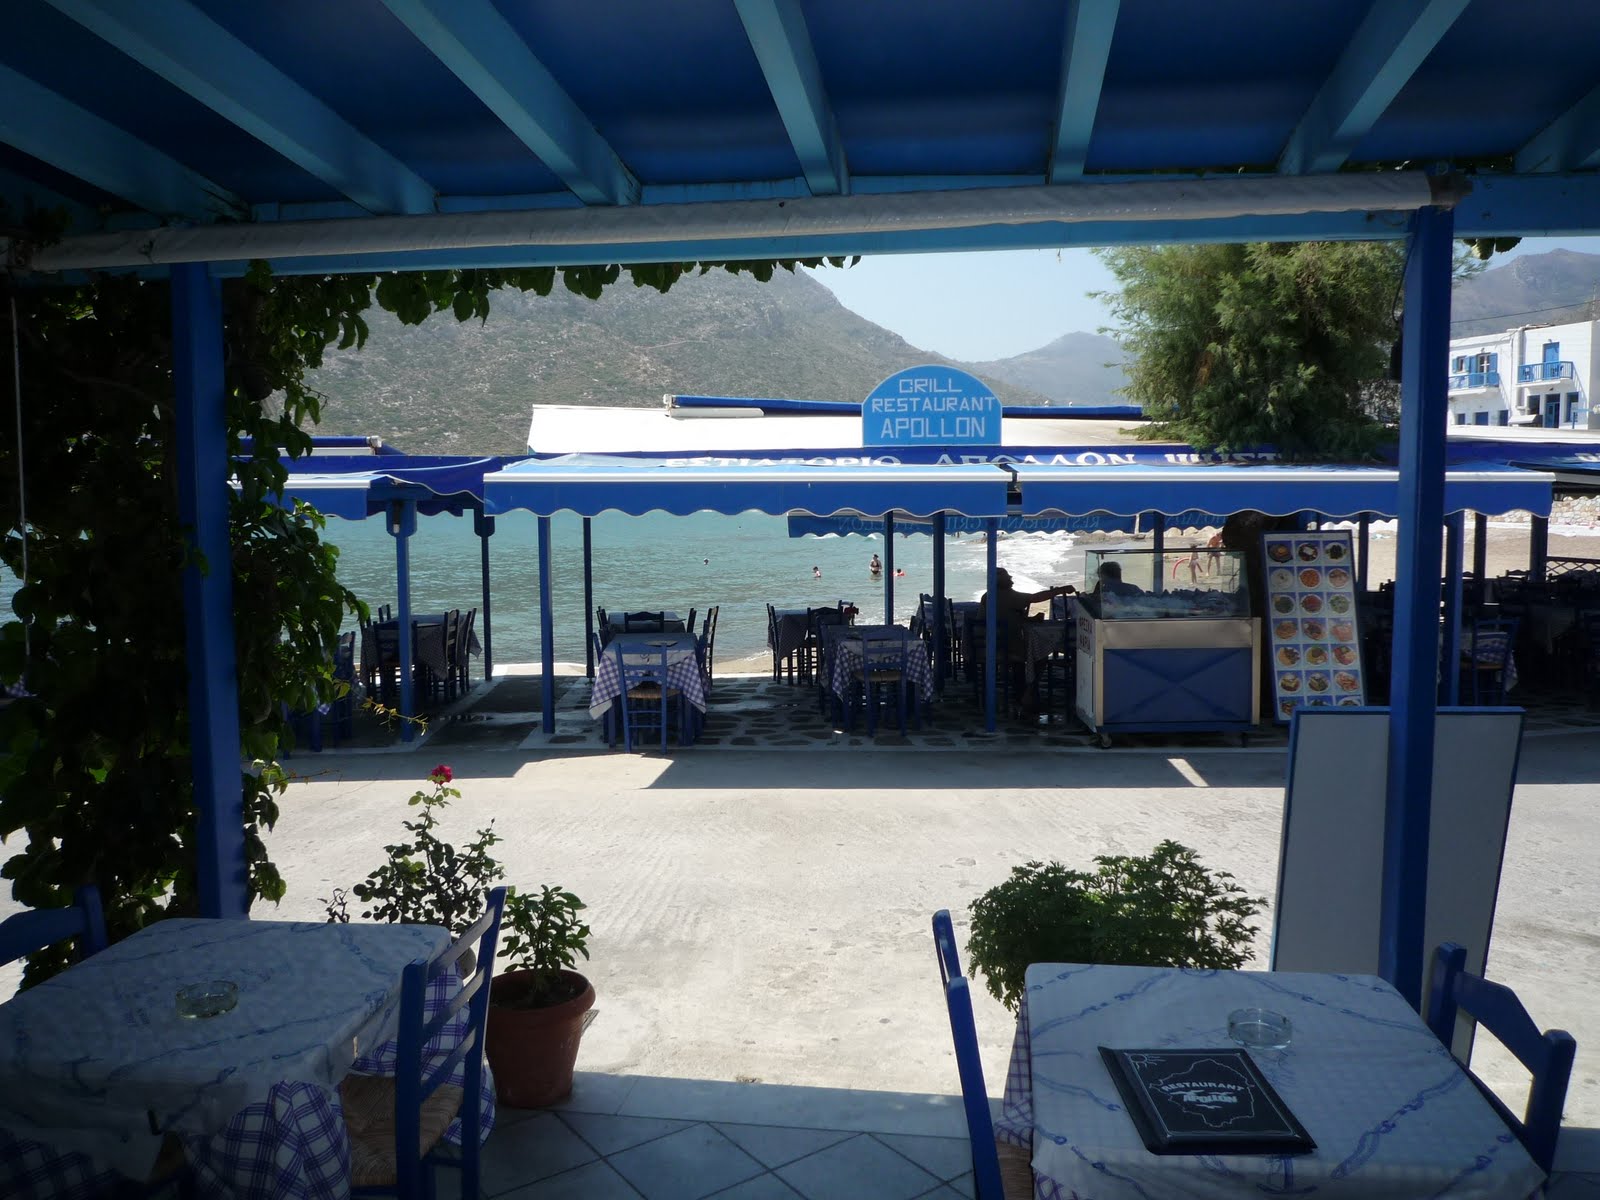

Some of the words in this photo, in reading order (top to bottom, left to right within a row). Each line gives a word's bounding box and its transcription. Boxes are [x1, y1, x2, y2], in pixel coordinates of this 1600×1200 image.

[899, 378, 963, 393] GRILL
[871, 396, 996, 413] RESTAURANT
[880, 416, 986, 439] APOLLON
[1161, 1081, 1245, 1092] RESTAURANT
